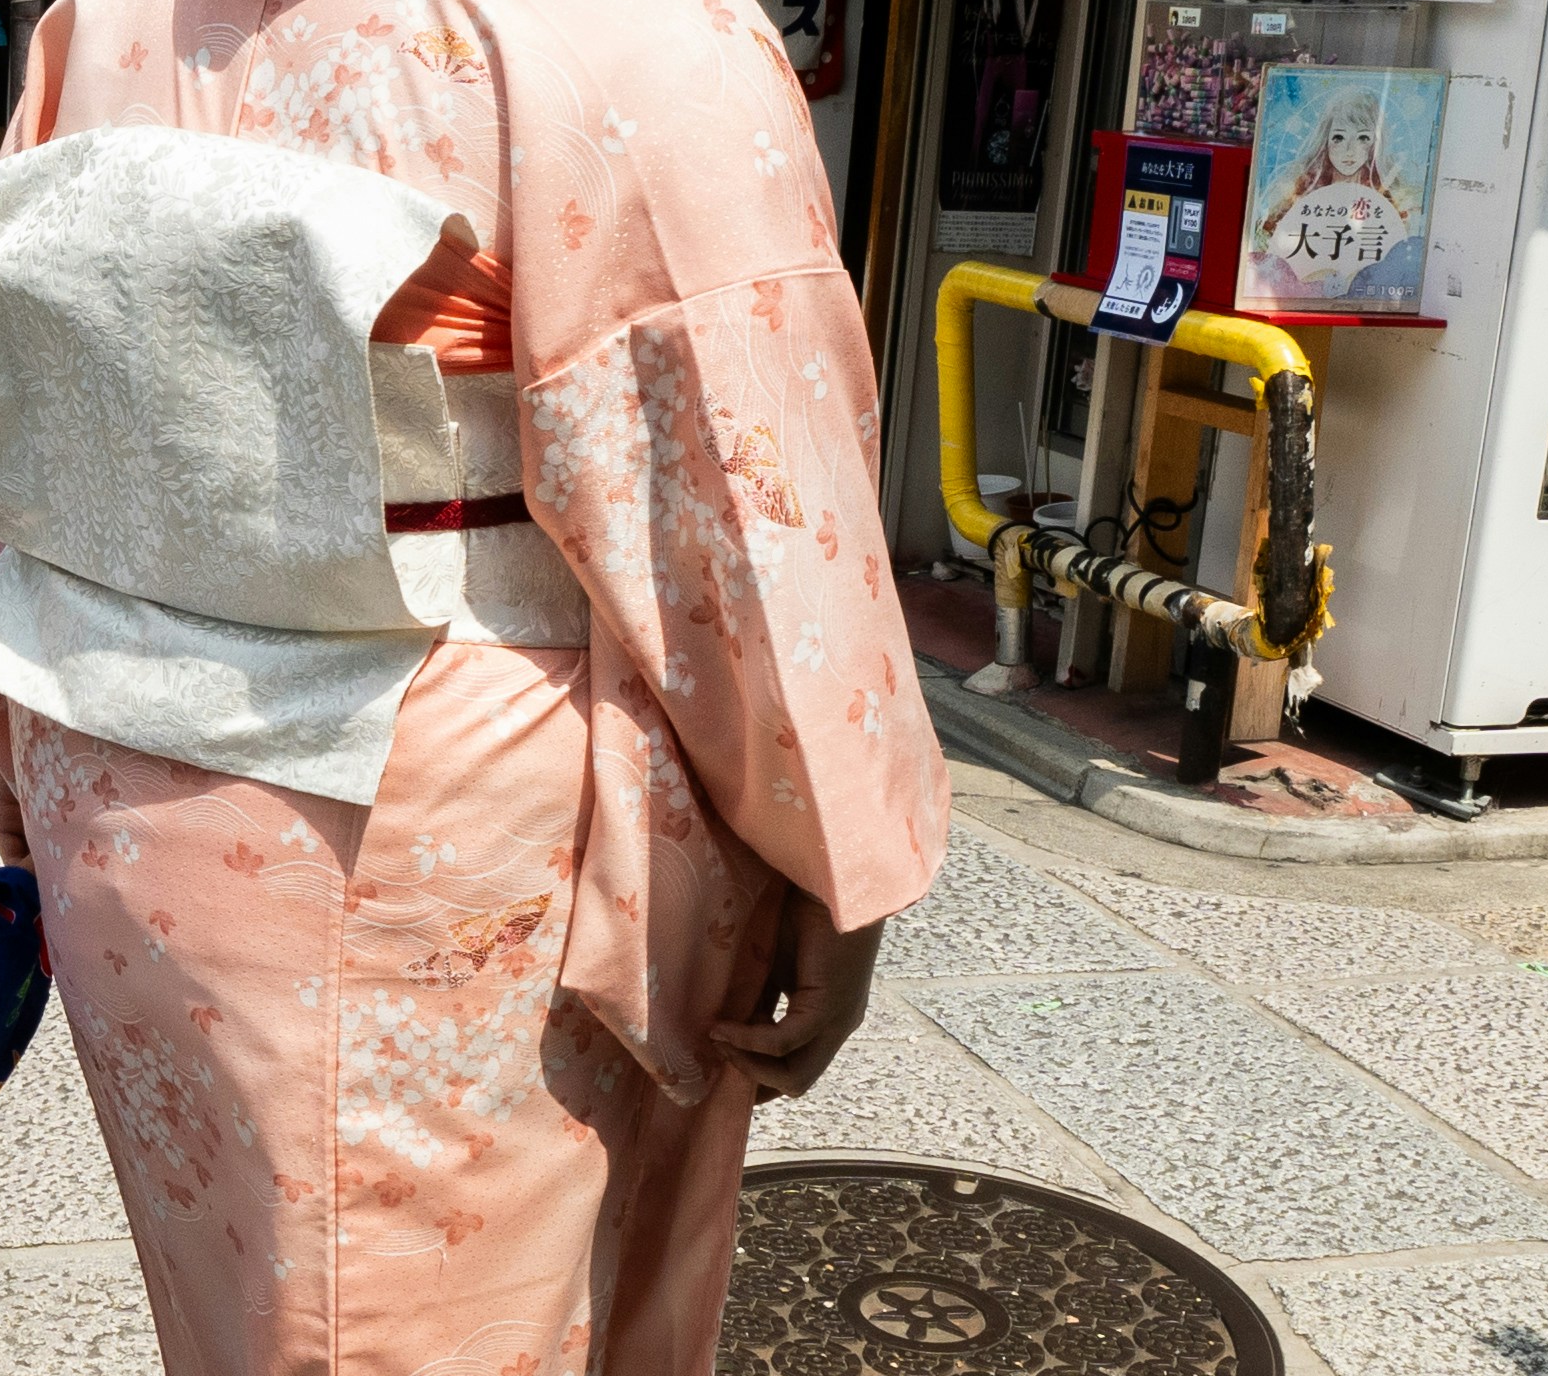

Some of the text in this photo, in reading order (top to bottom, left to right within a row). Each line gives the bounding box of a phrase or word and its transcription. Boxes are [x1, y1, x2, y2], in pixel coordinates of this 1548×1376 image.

[1300, 197, 1385, 222] あなたの恋を
[1285, 223, 1390, 263] 大予言
